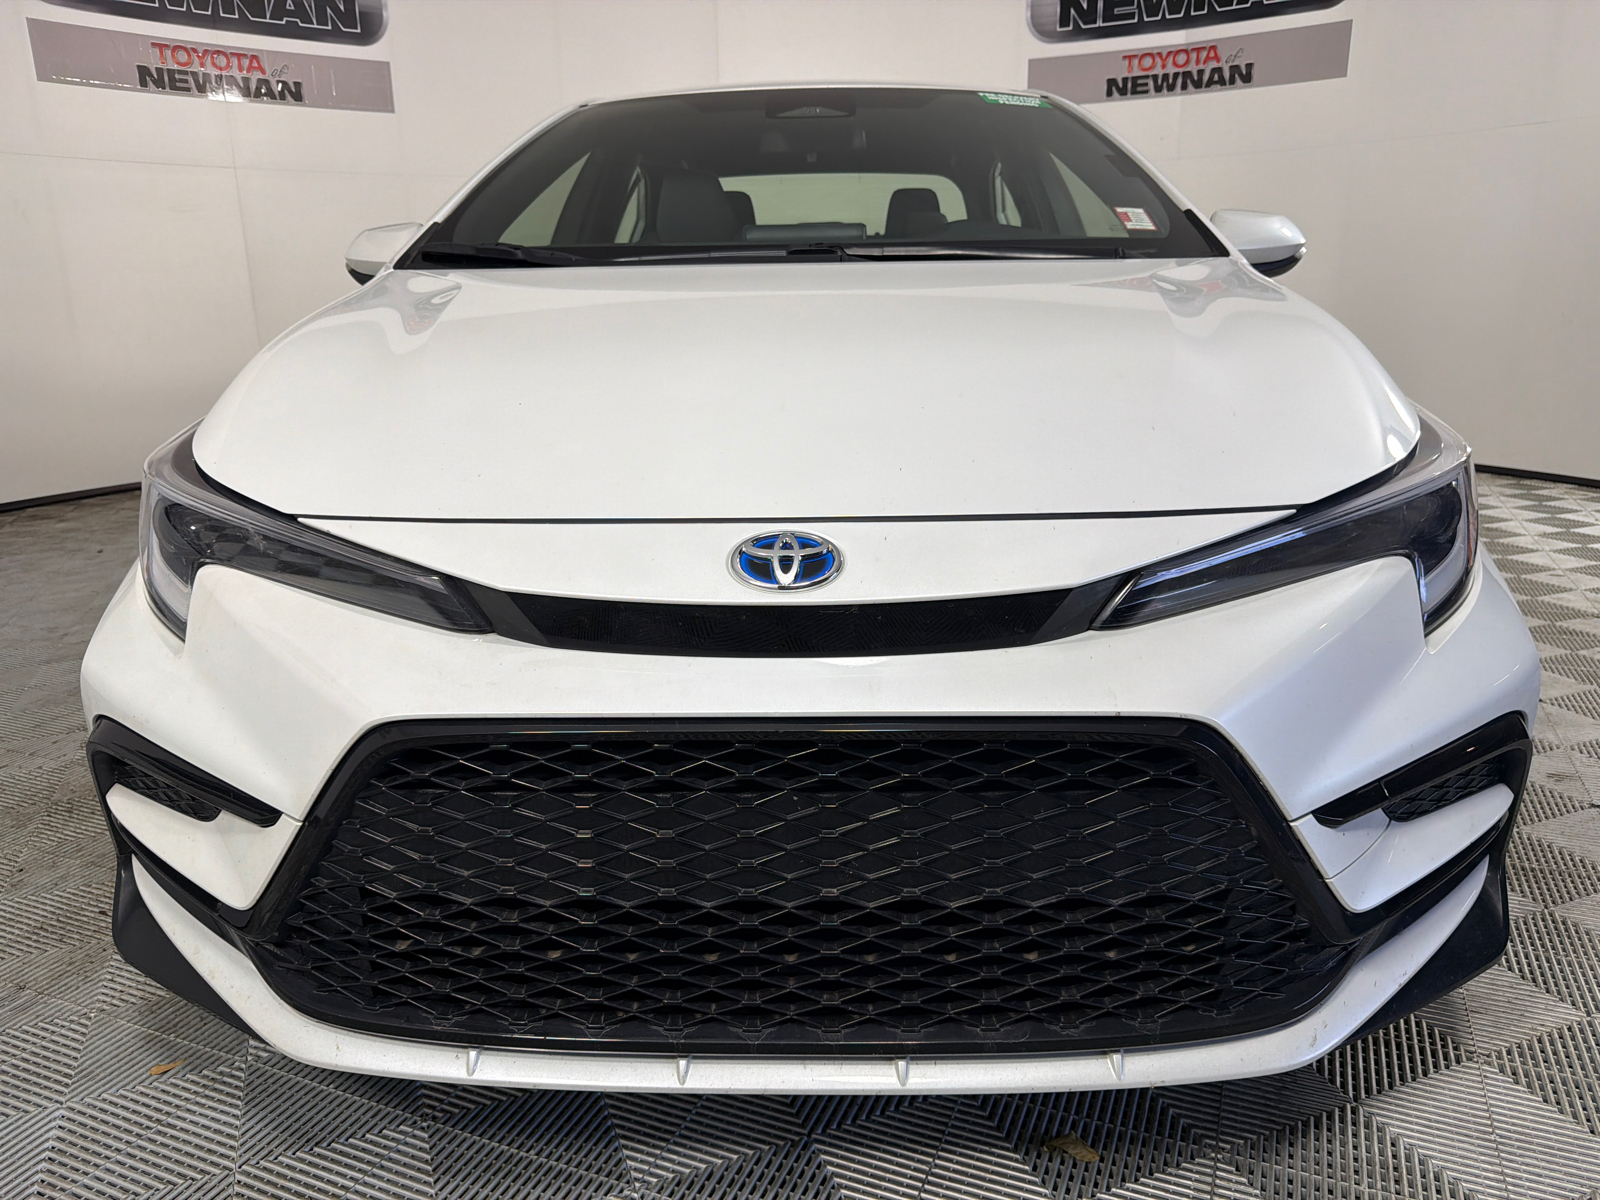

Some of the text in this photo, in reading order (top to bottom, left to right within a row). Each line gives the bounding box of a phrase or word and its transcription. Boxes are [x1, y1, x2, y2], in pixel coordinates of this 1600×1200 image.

[150, 42, 290, 79] TOYOTA of
[1122, 44, 1244, 74] TOYOTA of
[135, 64, 303, 102] NEWNAN
[1105, 62, 1254, 97] NEWNAN
